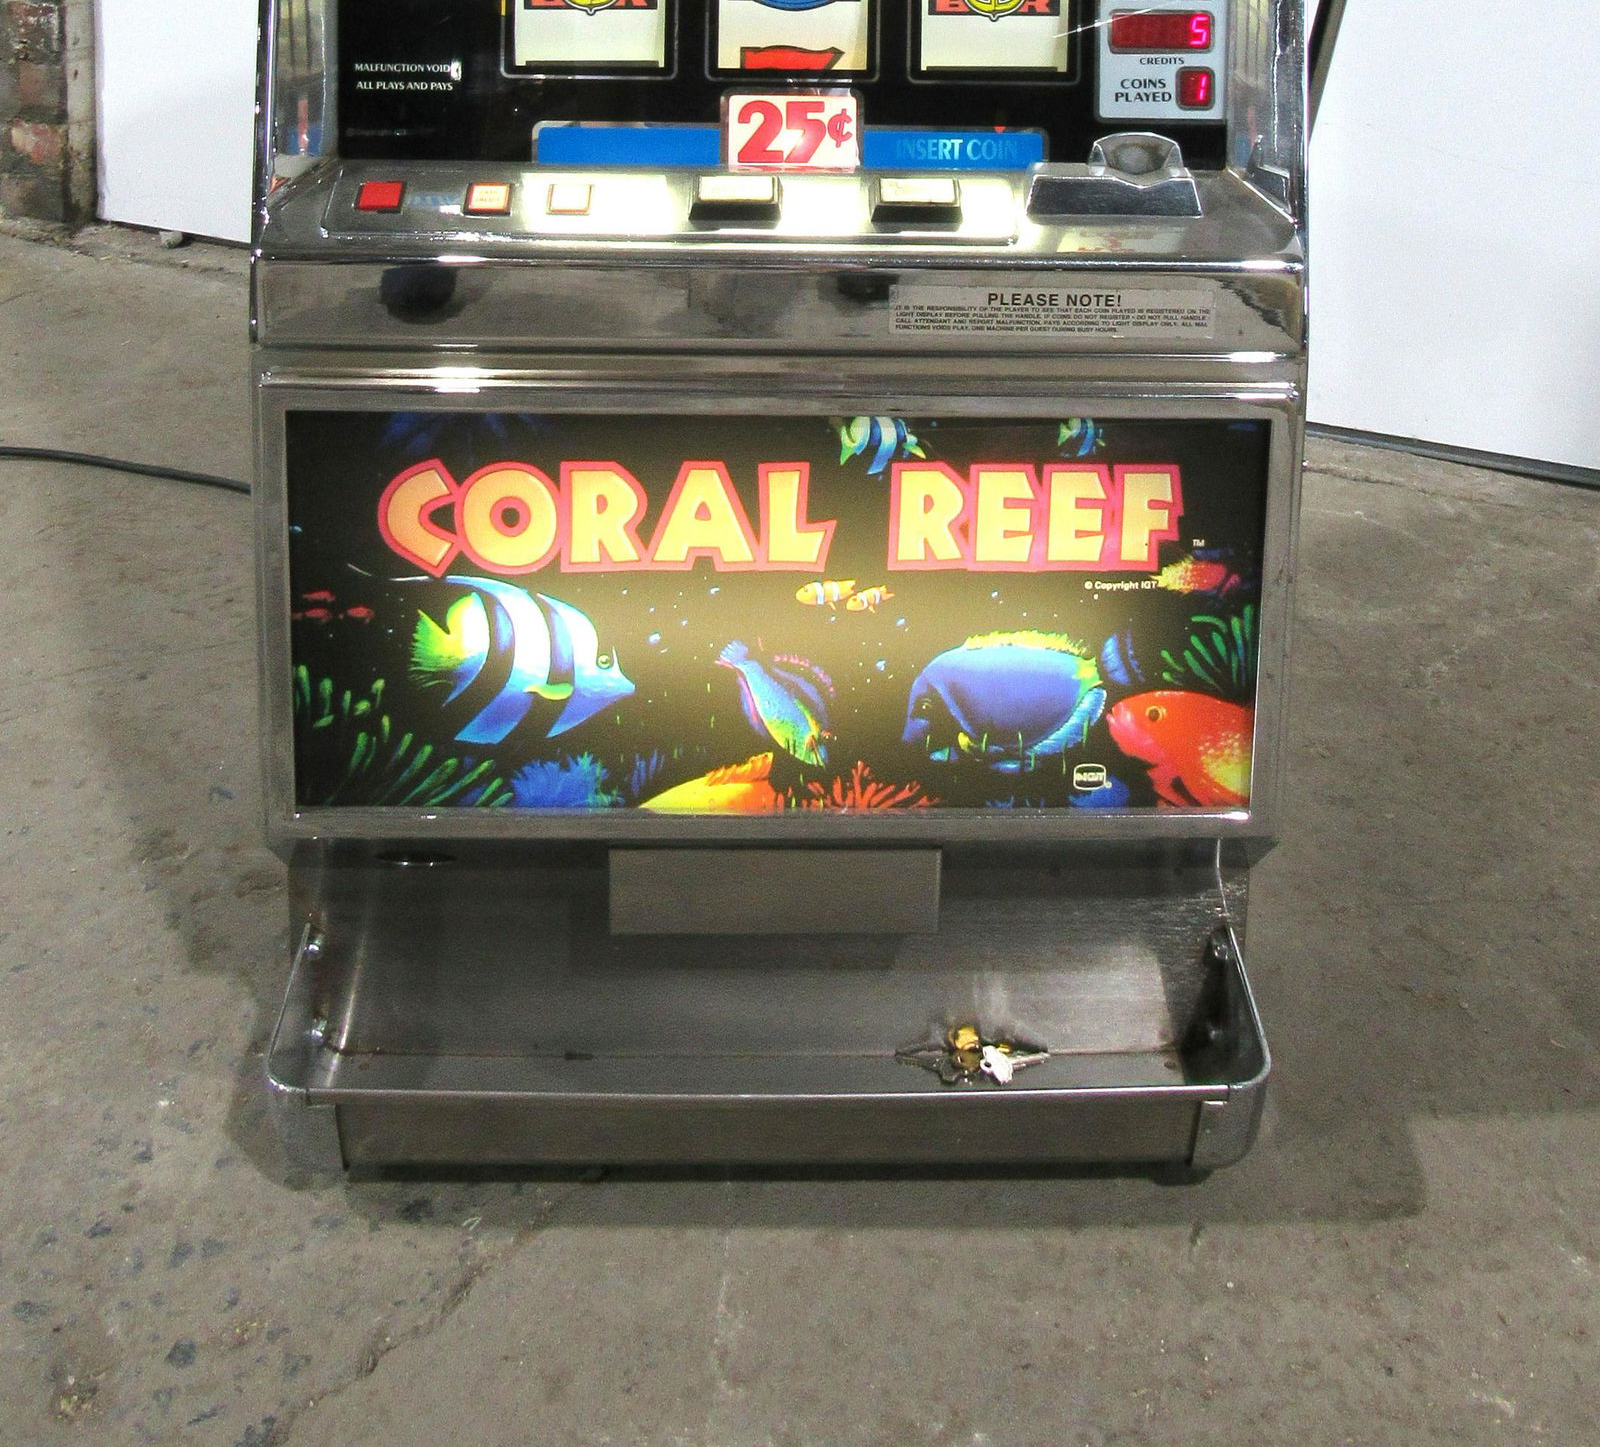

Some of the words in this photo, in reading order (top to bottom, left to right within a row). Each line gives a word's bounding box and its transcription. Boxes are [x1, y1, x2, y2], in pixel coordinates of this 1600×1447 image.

[1190, 14, 1211, 46] 5
[354, 63, 424, 72] MALFUNCTION
[1139, 57, 1185, 65] CREDITS
[356, 81, 373, 89] ALL
[376, 82, 405, 90] PLAYS
[406, 82, 428, 90] AND
[430, 82, 453, 91] PAYS
[1120, 78, 1167, 90] COINS
[1198, 73, 1208, 102] 1
[1114, 91, 1172, 103] PLAYED
[737, 100, 853, 164] 25¢
[896, 139, 963, 160] INSERT
[966, 139, 1017, 160] COIN
[988, 293, 1059, 306] PLEASE
[1066, 294, 1121, 307] NOTE!
[378, 458, 836, 576] CORAL
[888, 461, 1184, 573] REEF
[1094, 580, 1140, 591] Copyright
[1141, 581, 1157, 589] IGT
